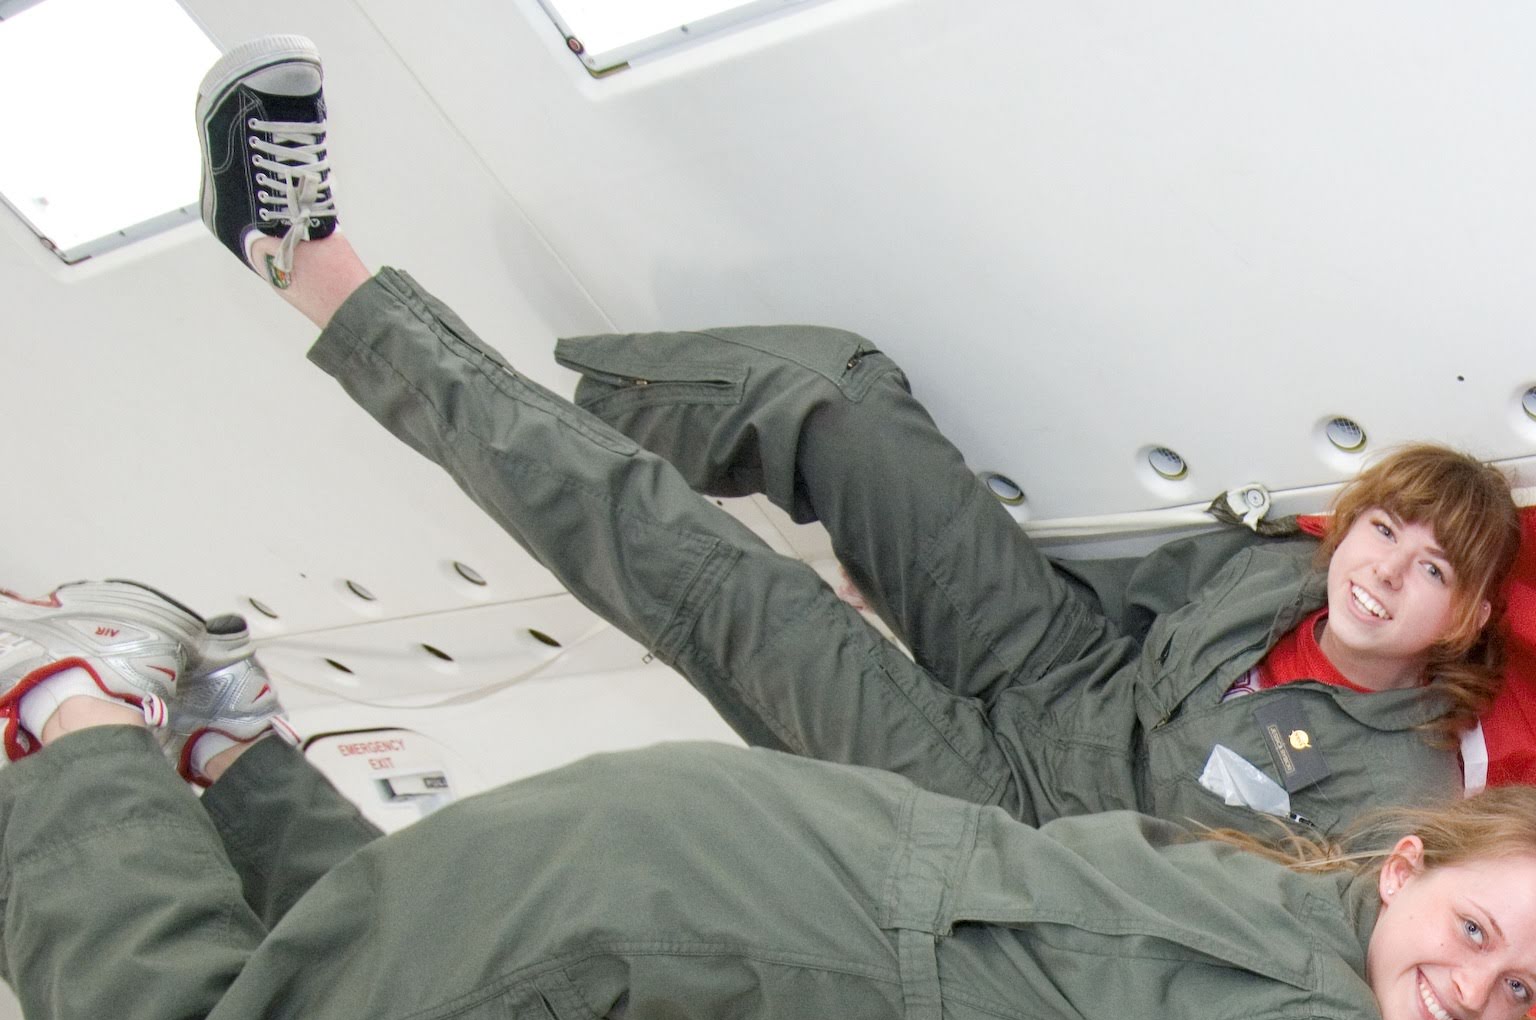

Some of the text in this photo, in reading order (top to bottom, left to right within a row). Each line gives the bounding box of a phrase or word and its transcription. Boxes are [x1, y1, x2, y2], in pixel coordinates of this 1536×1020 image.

[95, 626, 120, 637] AIR
[337, 739, 406, 757] EMERGENCY
[368, 757, 395, 770] EXIT
